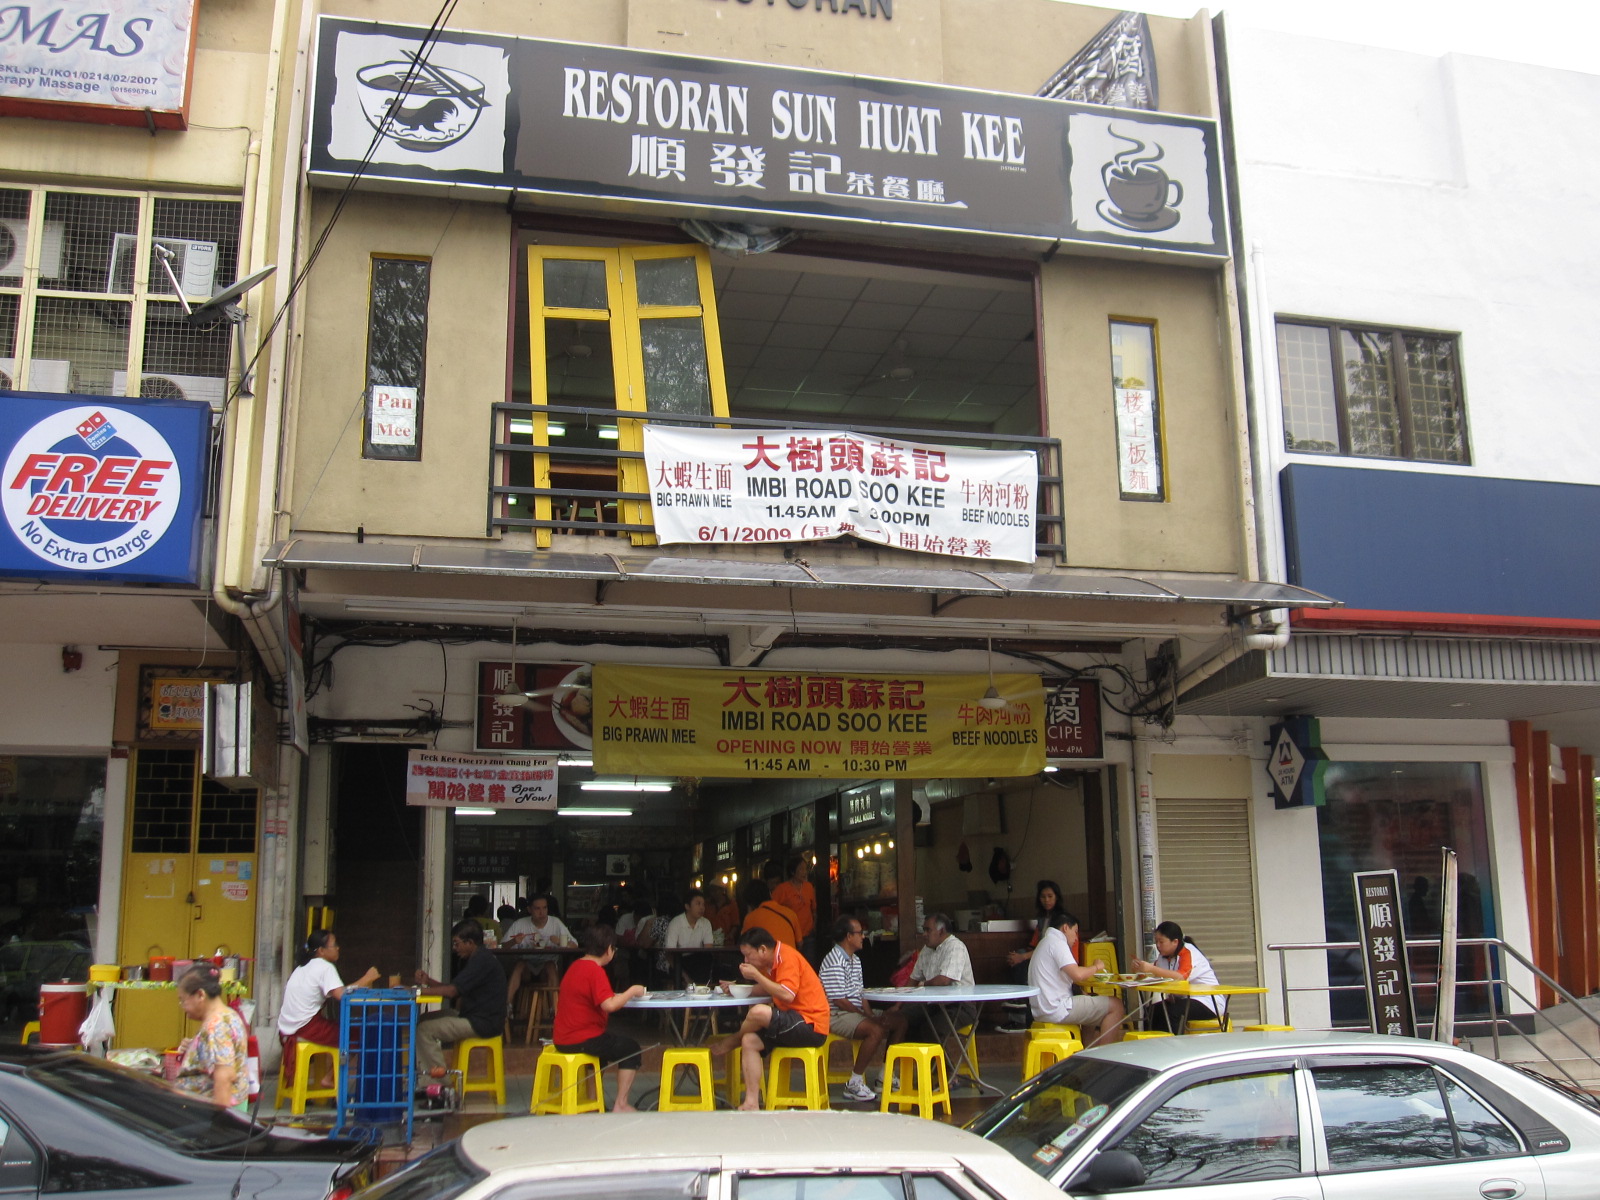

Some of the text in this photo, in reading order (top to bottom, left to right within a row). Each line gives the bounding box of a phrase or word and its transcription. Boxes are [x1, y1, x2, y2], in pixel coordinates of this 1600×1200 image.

[39, 76, 100, 93] Massage
[562, 67, 1026, 166] RESTORAN SUN HUAT KEE
[377, 393, 412, 409] Pan
[377, 422, 411, 437] Mee
[742, 436, 950, 482] 大樹頭蘇記
[10, 453, 173, 497] FREE
[655, 461, 732, 490] 大蝦生面
[657, 492, 732, 508] BIG PRAWN MEE
[747, 477, 945, 508] IMBI ROAD SOO KEE
[960, 479, 1029, 510] 牛肉河粉
[27, 495, 162, 521] DELIVERY
[766, 505, 836, 518] 11.45AM
[870, 508, 930, 527] 3.00PM
[962, 508, 1030, 527] BEEF NOODLES
[20, 520, 152, 564] No Extra Charge
[698, 526, 792, 542] 6/1/2009
[900, 532, 992, 557] 開始營業
[722, 676, 926, 711] 大樹頭蘇記
[609, 694, 691, 721] 大蝦生面
[722, 711, 928, 733] IMBI ROAD SOO KEE
[602, 726, 696, 744] BIG PRAWN MEE
[953, 729, 1038, 745] BEEF NOODLES
[1047, 725, 1082, 739] CIPE
[717, 740, 932, 755] OPENING NOW 開始營業
[1066, 745, 1083, 753] 4PM
[420, 753, 438, 762] Teck
[441, 755, 457, 763] Kee
[506, 759, 530, 767] Chang
[744, 759, 783, 771] 11:45
[787, 759, 810, 770] AM
[842, 760, 880, 771] 10:30
[885, 760, 907, 771] PM
[1281, 775, 1294, 785] ATM
[428, 780, 506, 803] 開始營業
[511, 784, 543, 796] Open
[514, 793, 551, 804] Now!
[1365, 886, 1389, 897] RESTORAN
